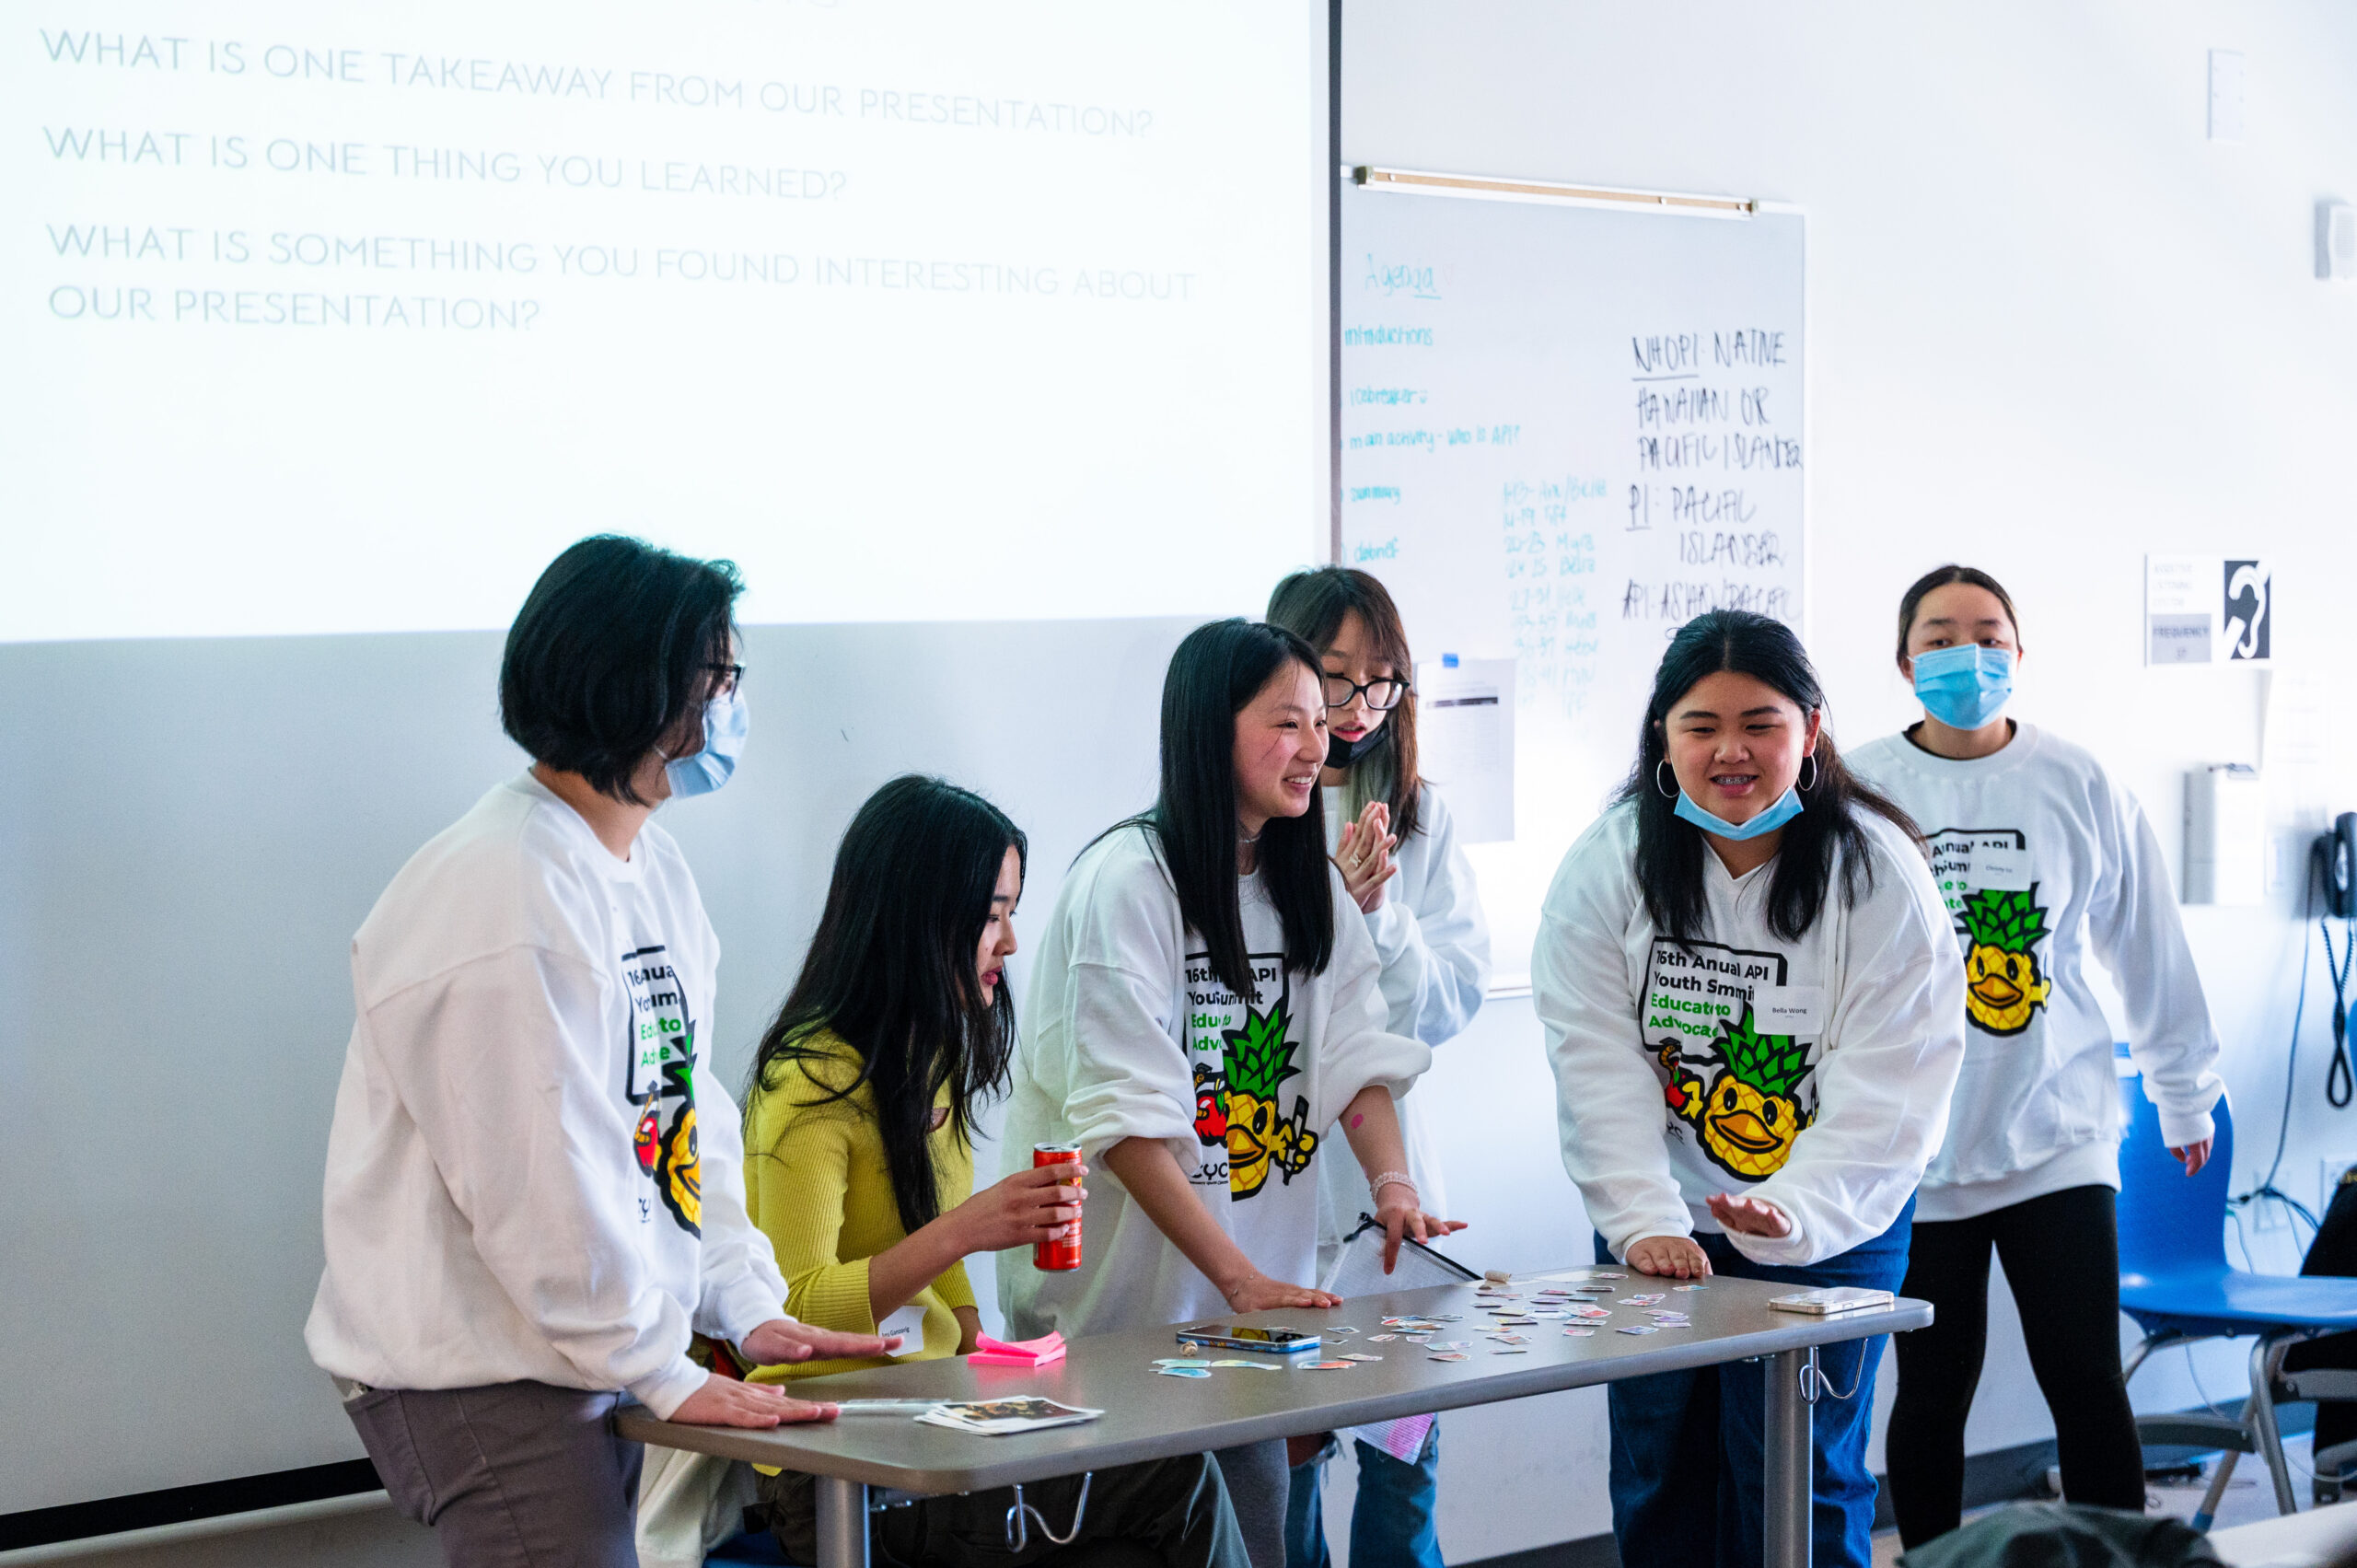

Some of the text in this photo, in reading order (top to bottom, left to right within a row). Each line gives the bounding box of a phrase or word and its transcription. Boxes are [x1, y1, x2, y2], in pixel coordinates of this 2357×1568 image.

[38, 28, 1155, 138] WHAT IS ONE TAKEAWAY FROM OUR PRESENTATION?
[41, 125, 847, 200] WHAT IS ONE THING YOU LEARNED?
[45, 223, 1197, 302] WHAT IS SOMETHING YOU FOUND INTERESTING ABOUT
[47, 285, 543, 331] OUR PRESENTATION?
[1740, 386, 1771, 426] OR
[1654, 971, 1701, 993] Youth
[1744, 965, 1769, 981] API
[658, 1016, 682, 1033] to
[1715, 1004, 1731, 1016] to
